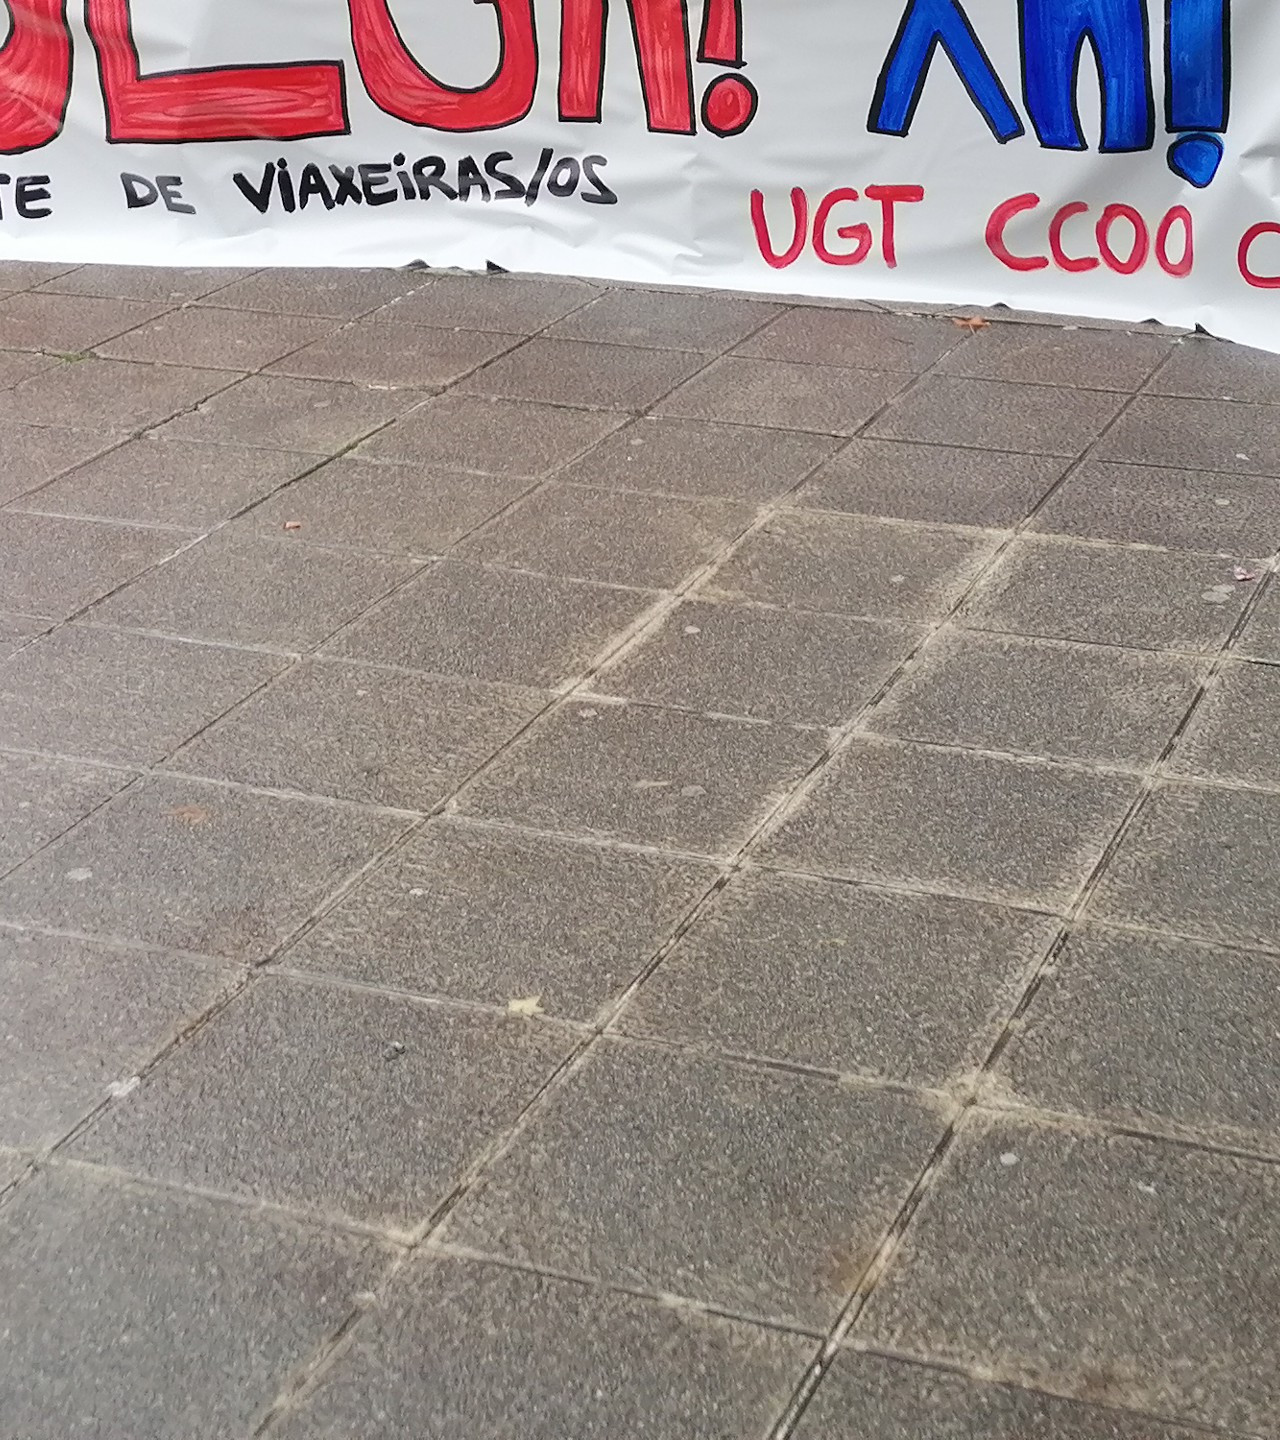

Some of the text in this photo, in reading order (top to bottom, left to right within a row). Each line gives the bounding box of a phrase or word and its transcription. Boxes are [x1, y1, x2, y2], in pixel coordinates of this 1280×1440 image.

[120, 171, 197, 215] DE
[750, 184, 925, 270] UGT
[984, 193, 1195, 278] CCOO
